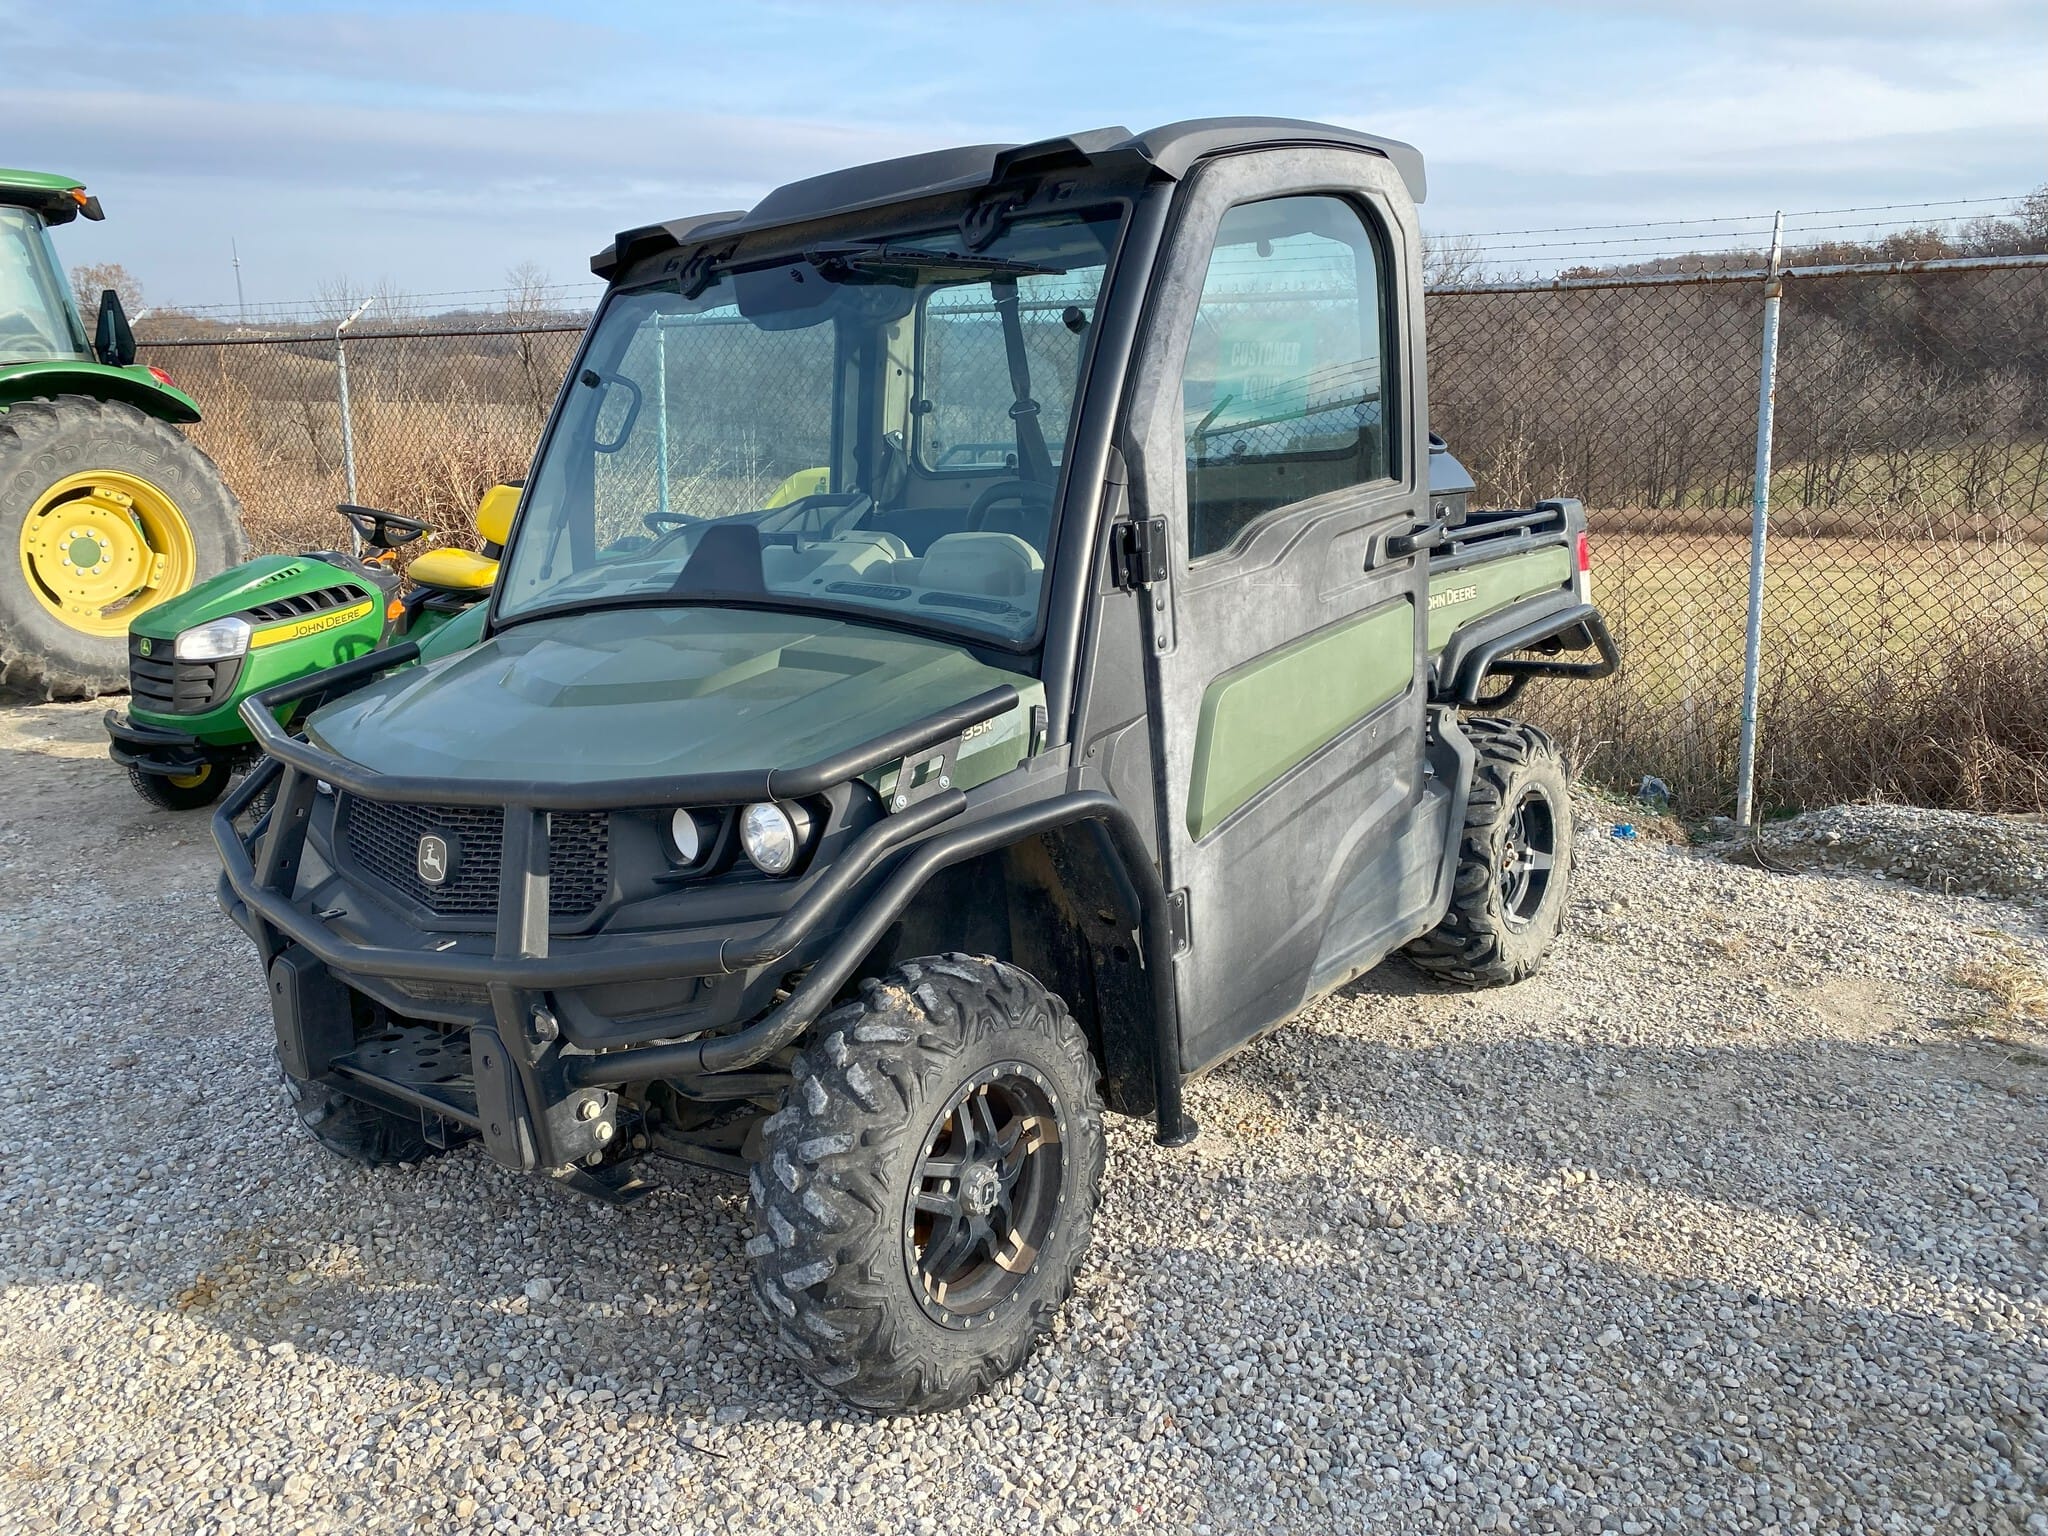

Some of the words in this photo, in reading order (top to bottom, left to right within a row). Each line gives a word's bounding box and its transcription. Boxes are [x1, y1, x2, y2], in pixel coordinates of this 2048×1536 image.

[1231, 342, 1301, 367] CUSTOMER
[1428, 593, 1446, 610] OHN
[1447, 585, 1477, 605] DEERE
[292, 621, 325, 638] JOHN
[326, 609, 360, 627] DEERE
[961, 719, 993, 742] 35R
